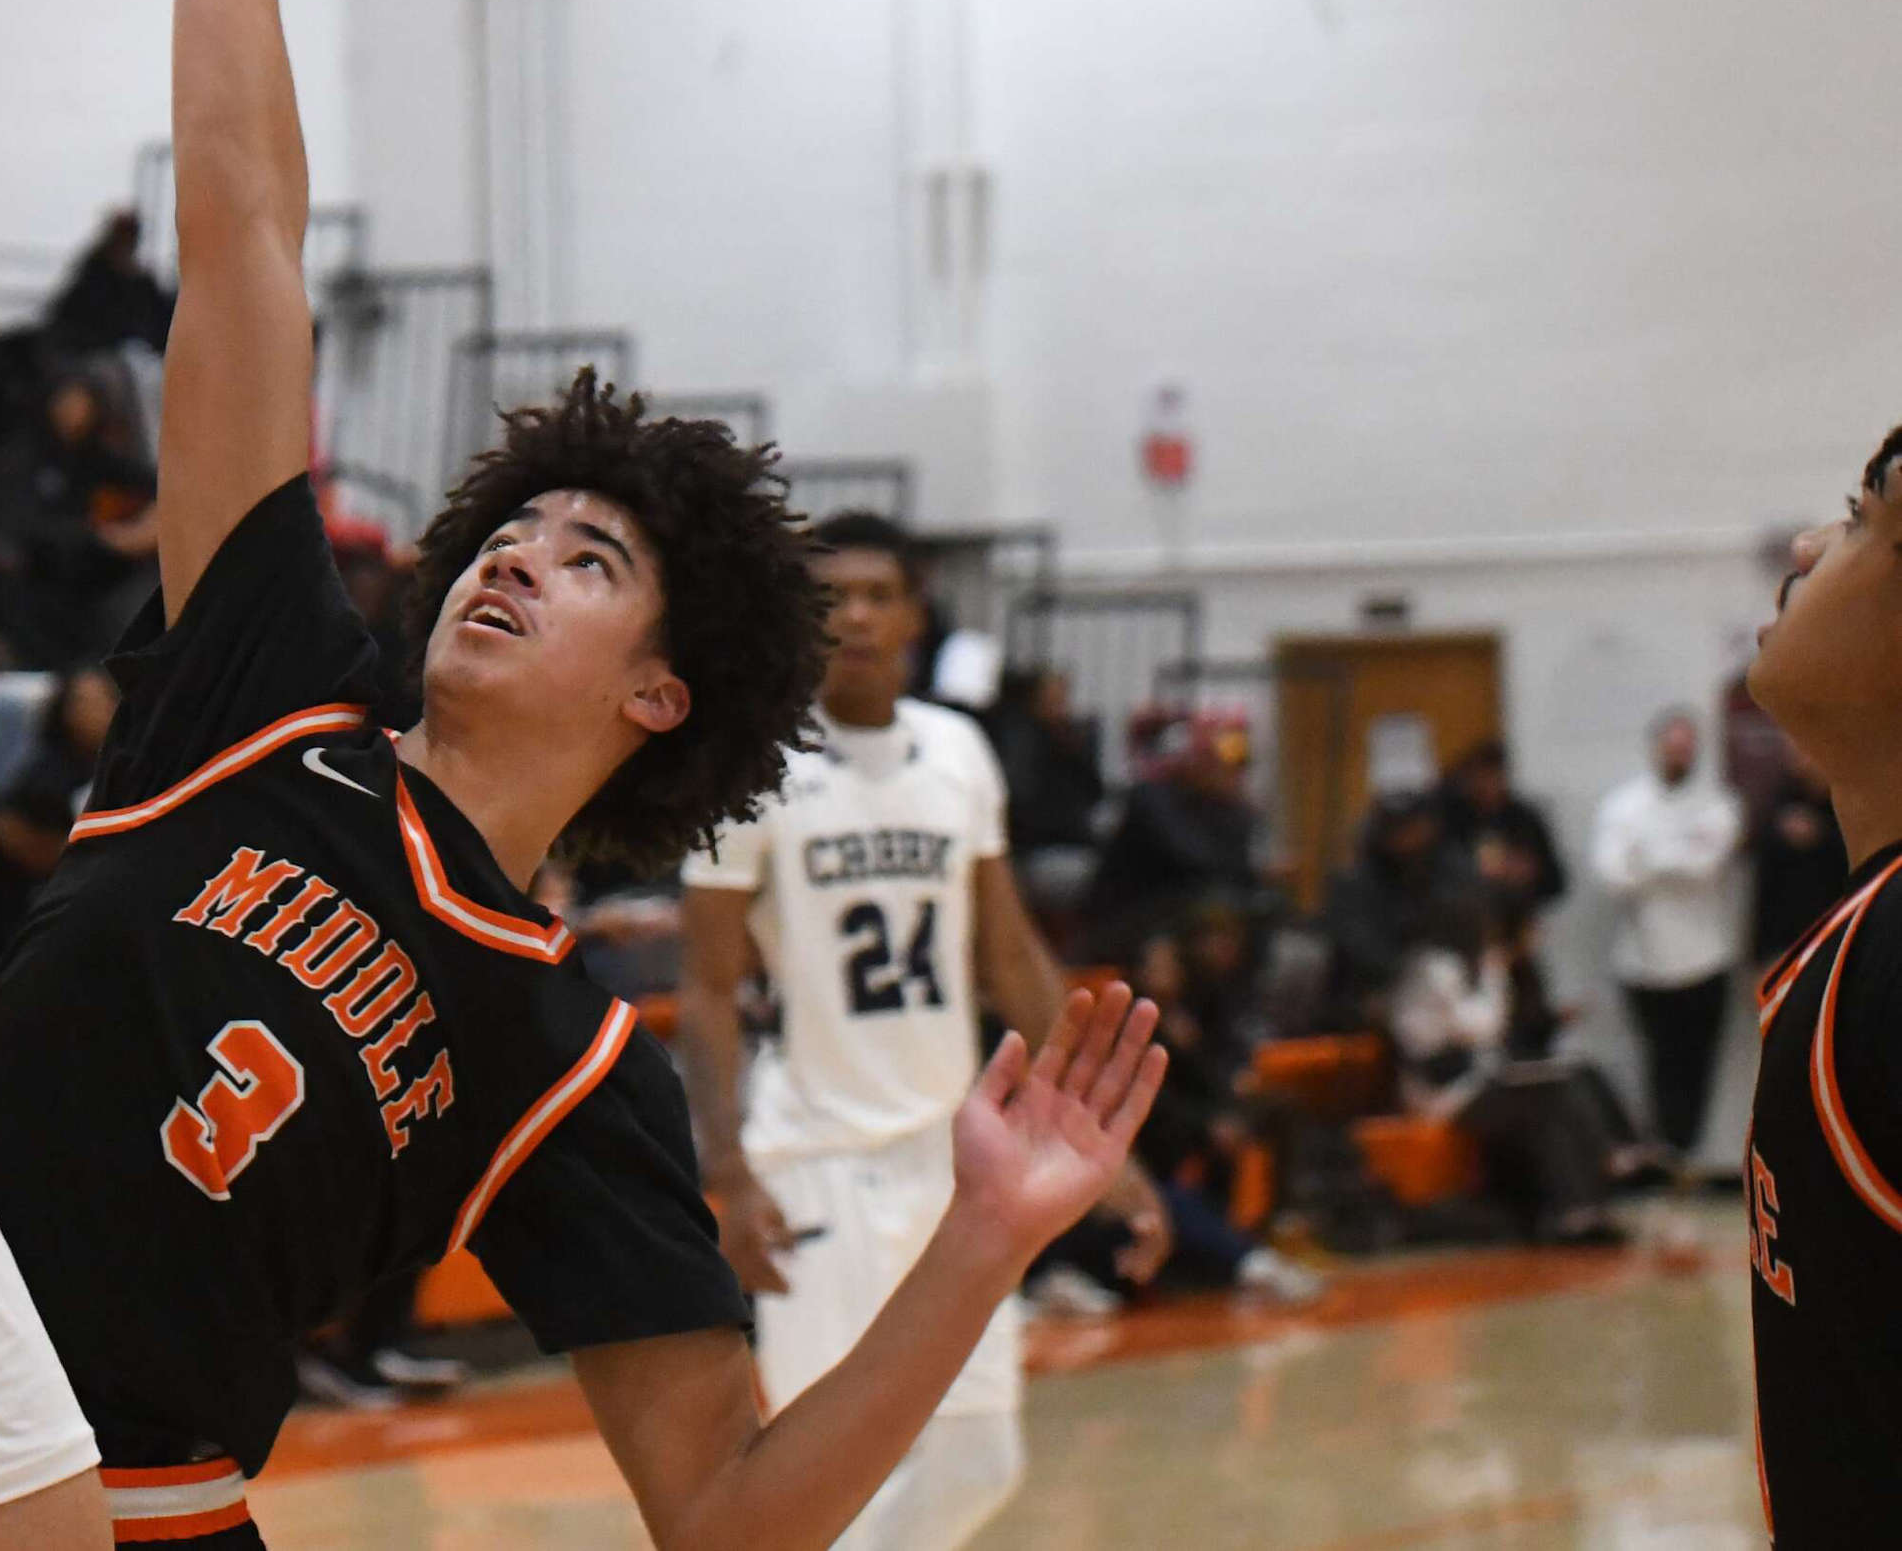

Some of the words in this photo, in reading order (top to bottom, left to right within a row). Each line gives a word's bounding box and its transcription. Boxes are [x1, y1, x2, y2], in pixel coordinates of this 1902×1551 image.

[171, 846, 454, 1159] MIDDLE
[840, 900, 943, 1016] 24
[160, 1020, 305, 1201] 3
